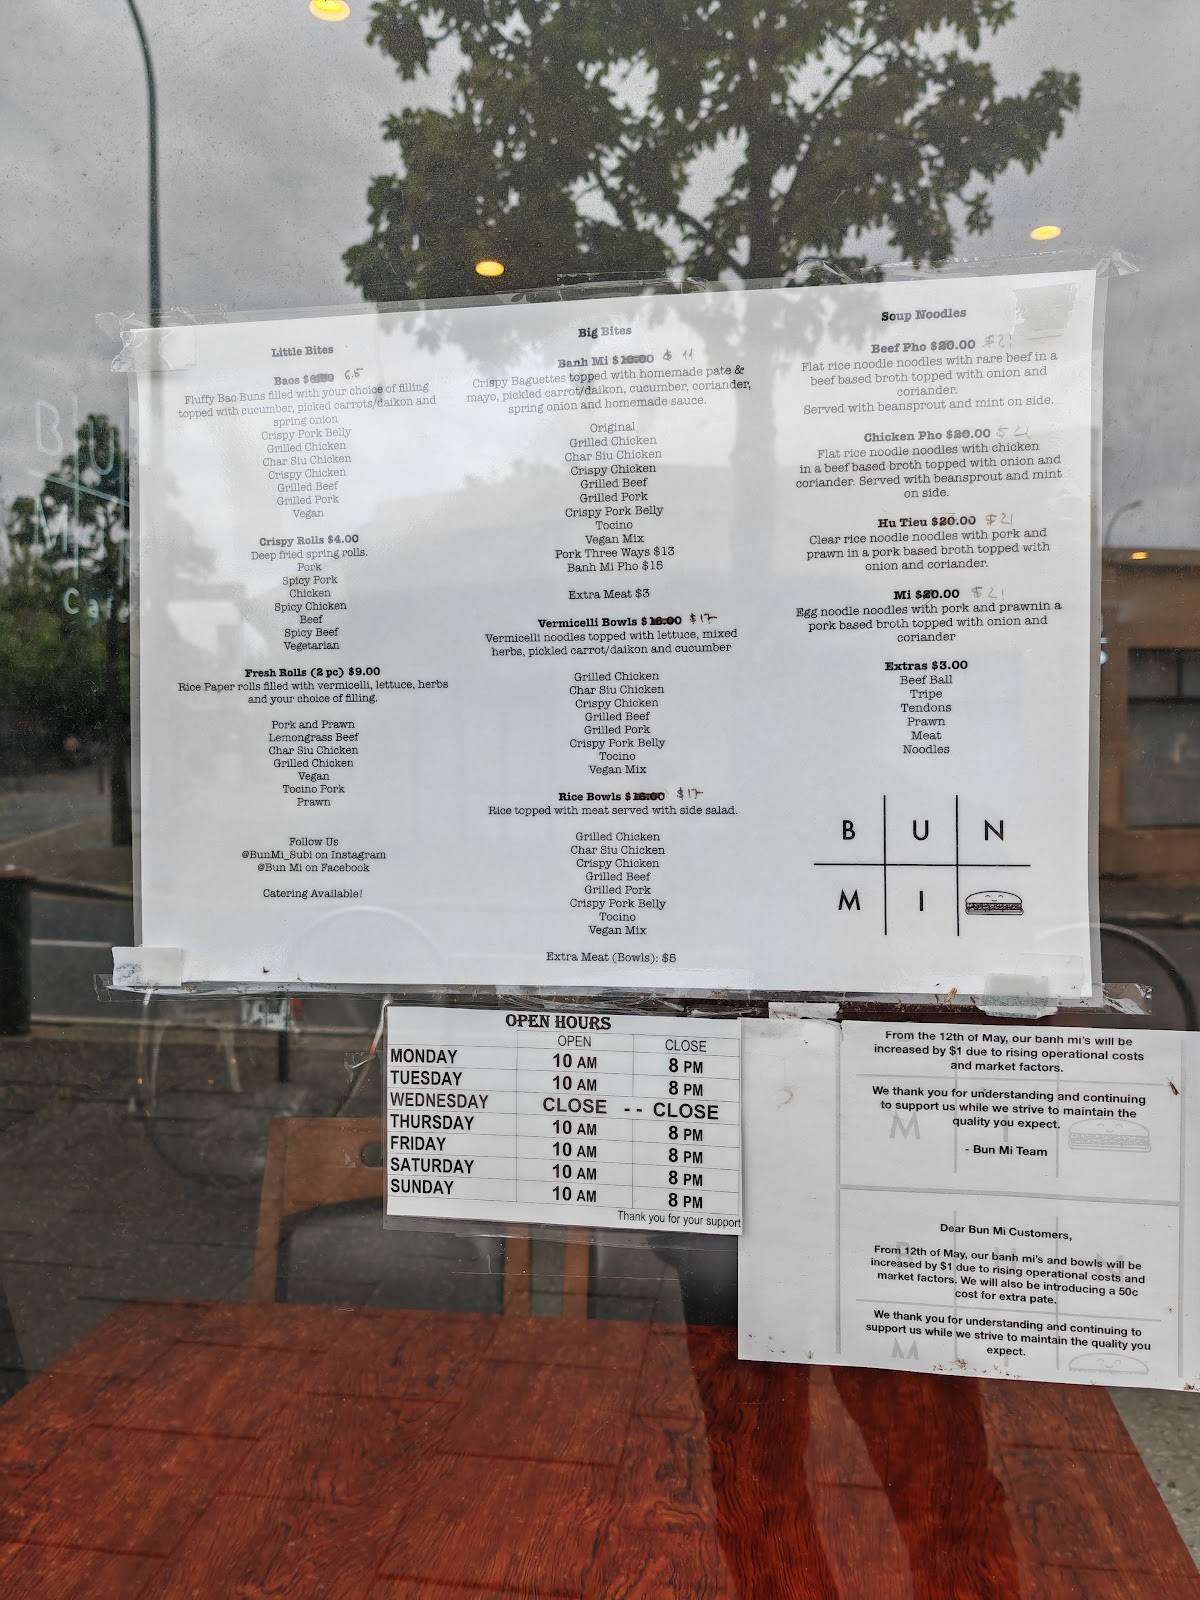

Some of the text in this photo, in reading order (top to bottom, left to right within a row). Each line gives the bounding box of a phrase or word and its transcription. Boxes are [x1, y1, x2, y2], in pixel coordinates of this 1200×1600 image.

[880, 308, 966, 322] Soup Noodles
[577, 325, 632, 339] Big Bites
[270, 344, 334, 358] Little Bites
[557, 357, 588, 368] Banh
[591, 355, 609, 366] Mi
[273, 375, 301, 386] Baos
[862, 431, 915, 442] Chicken
[917, 429, 942, 440] Pho
[876, 517, 896, 528] Hu
[898, 516, 928, 527] Tieu
[258, 533, 359, 548] Crispy Rolls $4.00
[584, 532, 644, 546] Vegan Mix
[554, 545, 675, 559] Pork Three Ways $13
[566, 559, 664, 573] Banh Mi Pho $15
[892, 589, 912, 600] Mi
[536, 617, 599, 628] Vermicelli
[600, 616, 638, 627] Bowls
[282, 640, 340, 652] Vegetarian
[884, 659, 968, 671] Extras $3.00
[244, 666, 380, 678] Fresh Rolls (2 pc) $9.00
[898, 674, 952, 685] Beef Ball
[908, 688, 943, 700] Tripe
[899, 702, 952, 712] Tendons
[906, 716, 946, 726] Prawn
[910, 730, 942, 740] Meat
[902, 744, 950, 754] Noodles
[557, 791, 584, 801] Rice
[585, 791, 622, 801] Bowls
[288, 836, 339, 846] Follow Us
[240, 849, 386, 861] @BunMi_Subi on Instagram
[262, 888, 362, 900] Catering Available!
[545, 951, 676, 964] Extra Meat (Bowls): $5
[504, 1013, 612, 1030] OPEN HOURS
[556, 1034, 592, 1047] OPEN
[884, 1030, 1132, 1046] From the 12th of May, our banh mi's will be
[664, 1038, 707, 1054] CLOSE
[873, 1043, 1144, 1061] increased by $1 due to rising operational costs
[390, 1047, 703, 1074] MONDAY 10 AM 8 PM
[949, 1060, 1063, 1072] and market factors.
[390, 1069, 703, 1096] TUESDAY 10 AM 8 PM
[390, 1091, 719, 1120] WEDNESDAY CLOSE CLOSE
[390, 1113, 703, 1141] THURSDAY 10 AM 8 PM
[390, 1135, 703, 1164] FRIDAY 10 AM 8 PM
[972, 1144, 1048, 1156] Bun Mi Team
[390, 1156, 703, 1186] SATURDAY 10 AM 8 PM
[390, 1178, 702, 1209] SUNDAY 10 AM 8 PM
[616, 1209, 742, 1230] Thank you for your support
[939, 1222, 1072, 1241] Dear Bun Mi Customers,
[954, 1289, 1057, 1304] cost for extra pate.
